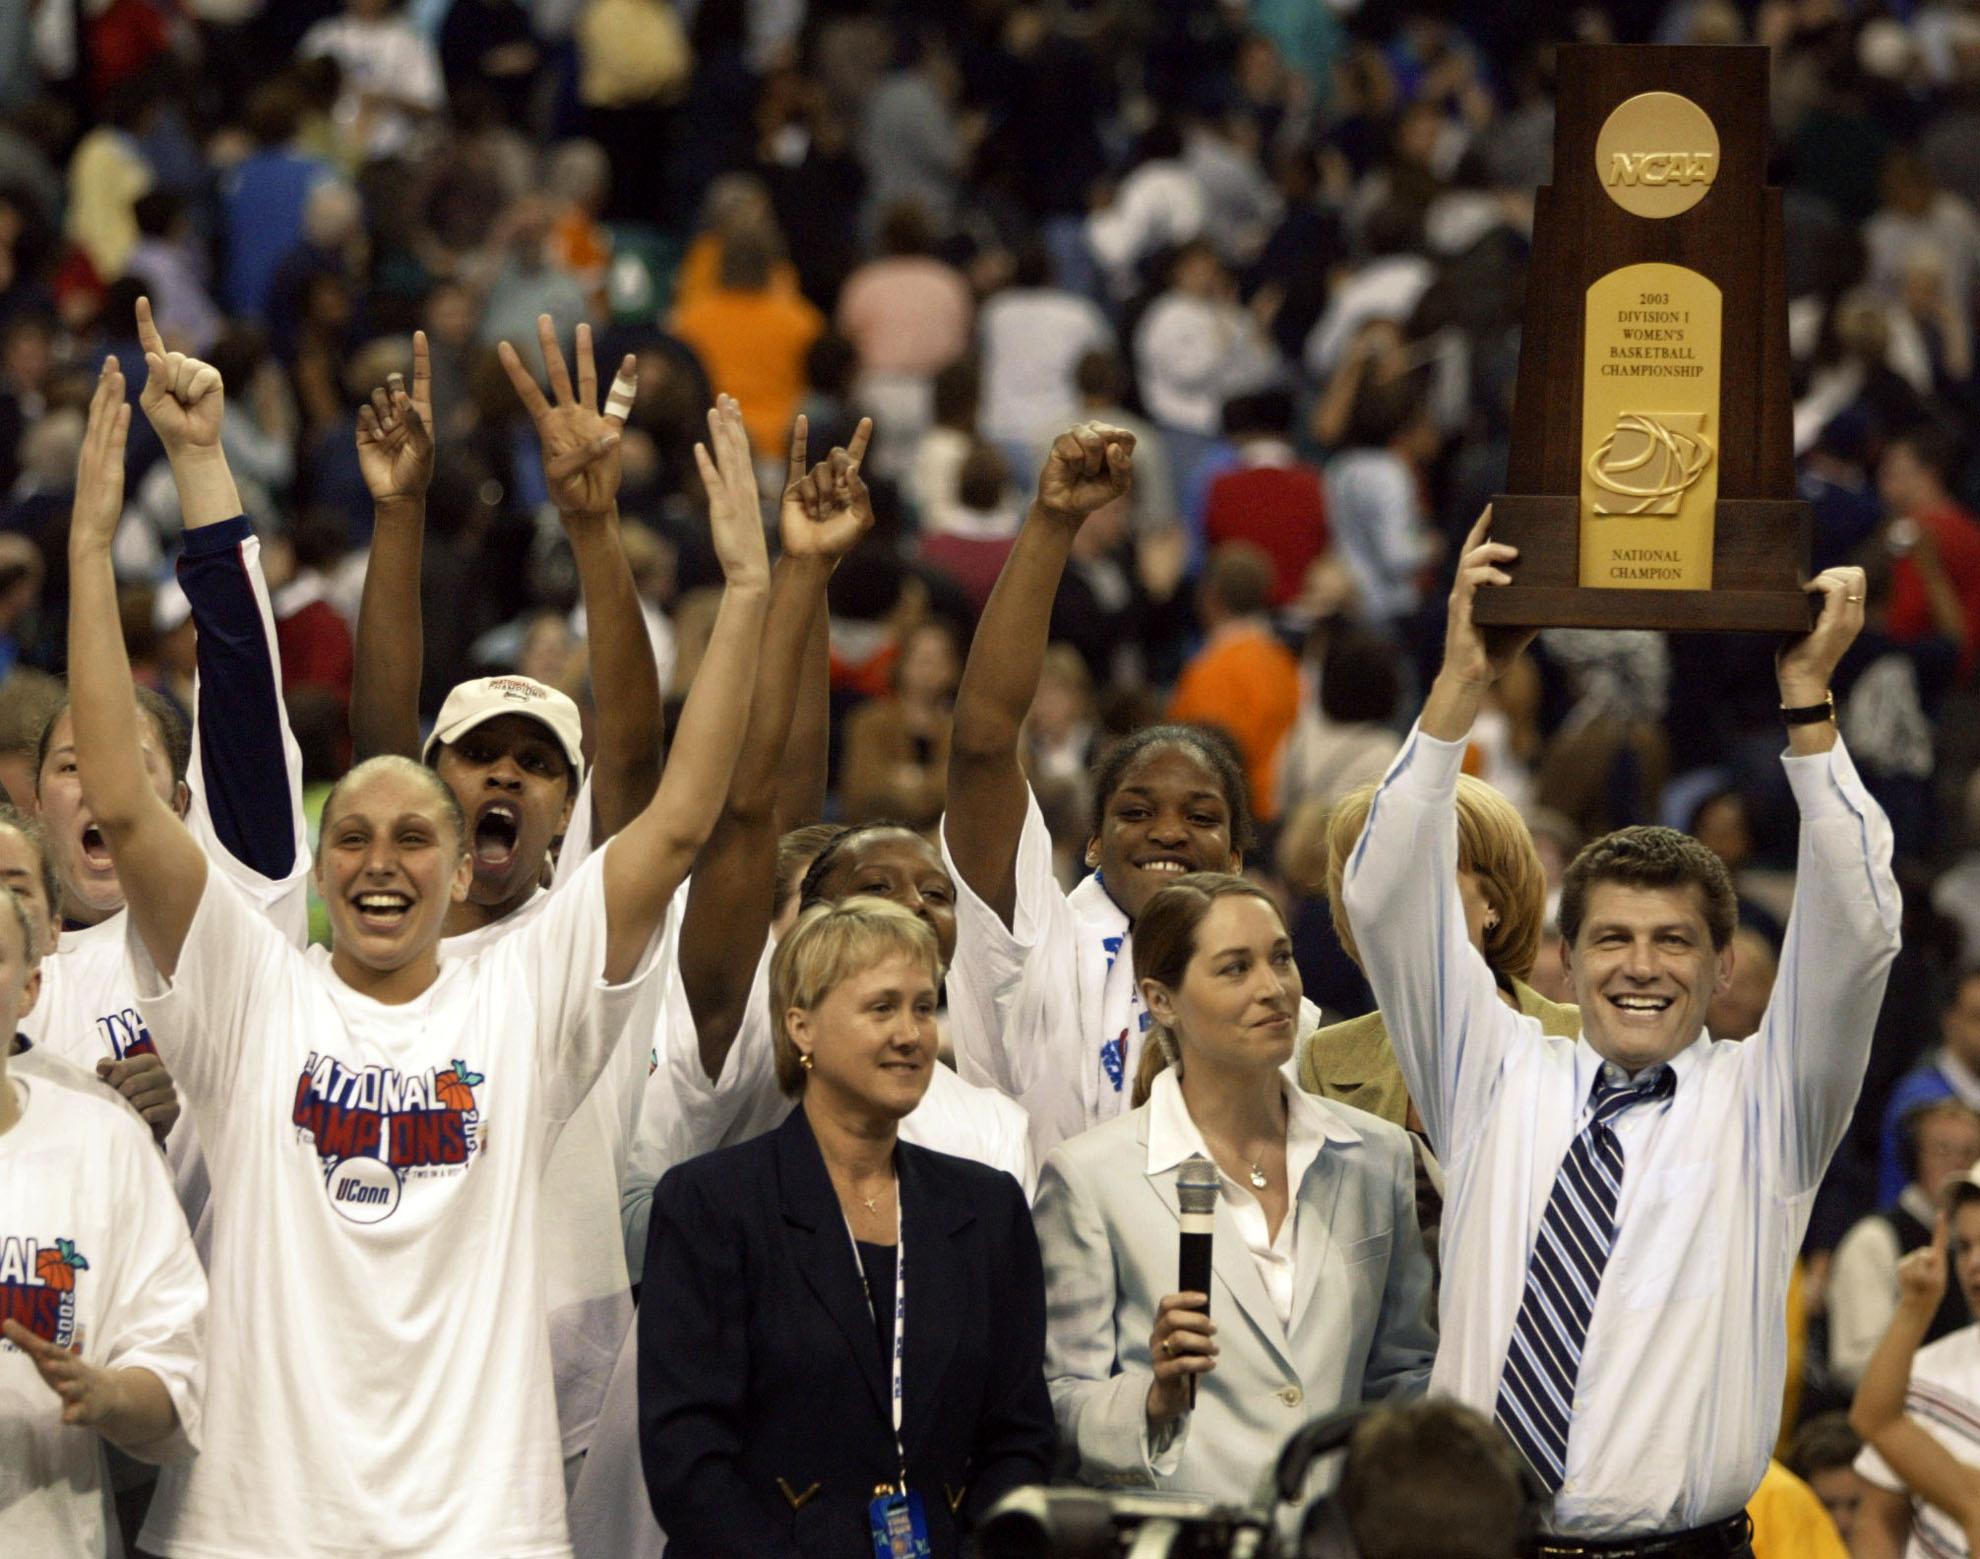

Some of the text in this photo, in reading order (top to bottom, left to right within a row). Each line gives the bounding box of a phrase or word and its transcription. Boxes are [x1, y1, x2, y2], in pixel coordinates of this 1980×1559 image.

[1608, 152, 1716, 187] NCAA
[1640, 293, 1669, 305] 2003
[1618, 311, 1690, 323] DIVISION I
[1623, 329, 1684, 341] WOMEN'S
[1610, 346, 1695, 360] BASKETBALL
[1601, 364, 1704, 378] CHAMPIONSHIP
[1611, 549, 1681, 562] NATIONAL
[1610, 567, 1682, 580] CHAMPION
[335, 1177, 390, 1205] UConn
